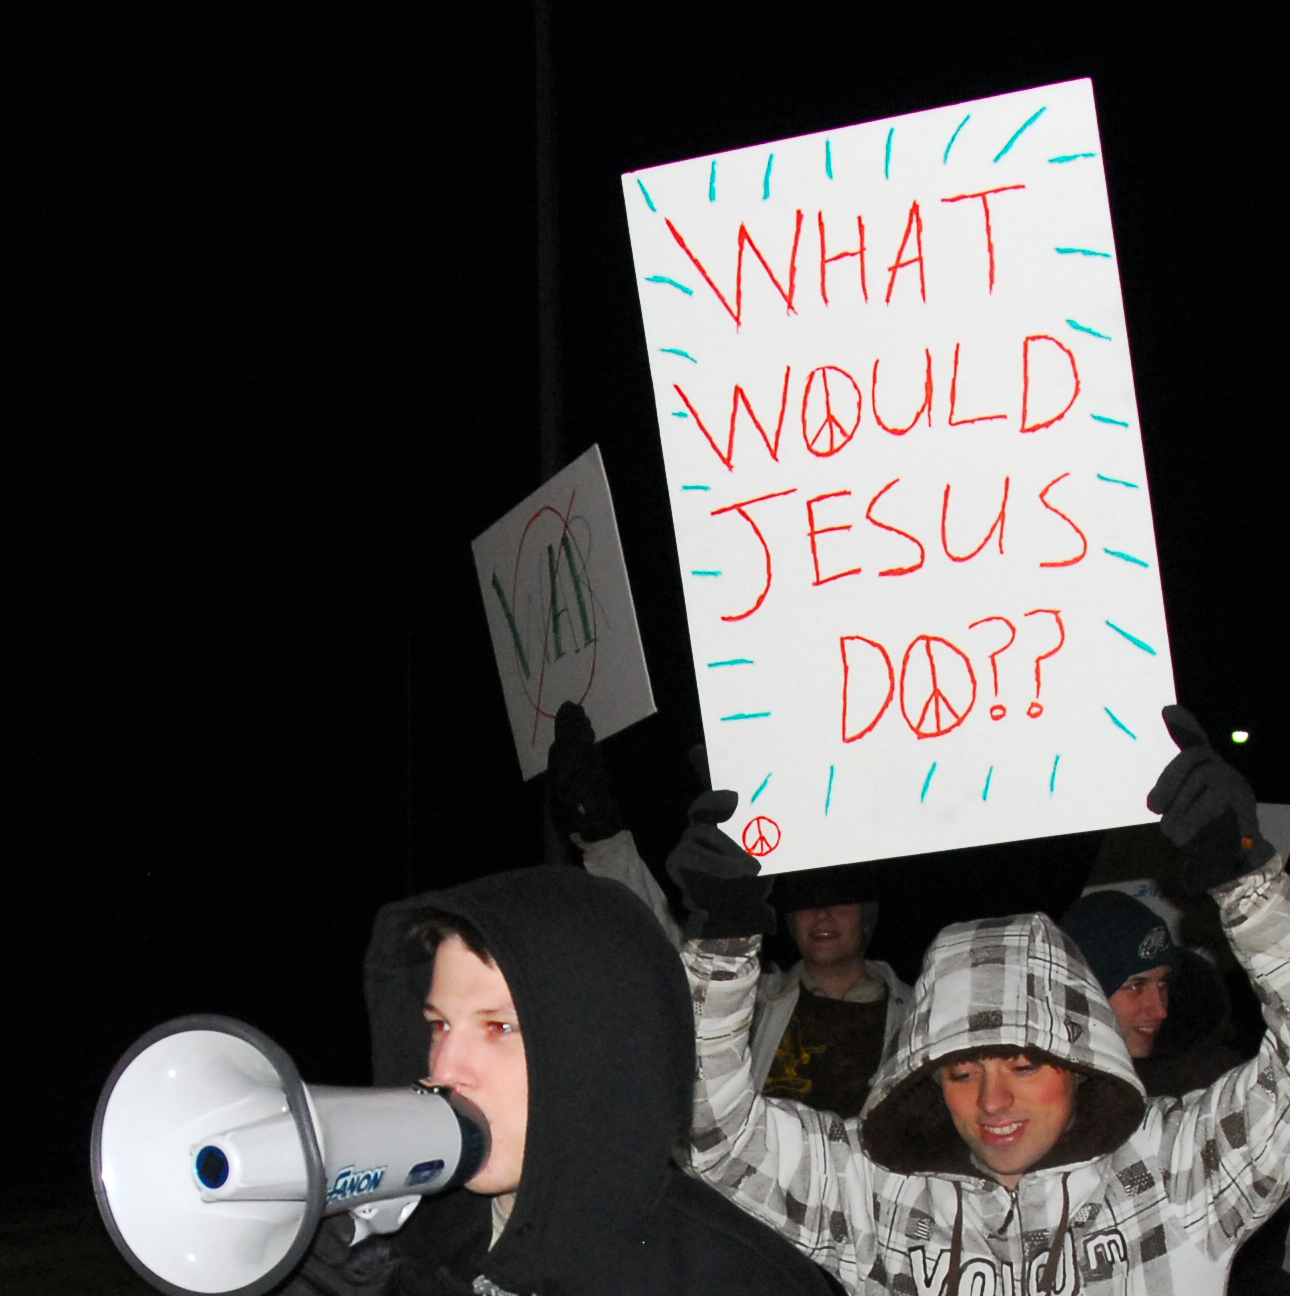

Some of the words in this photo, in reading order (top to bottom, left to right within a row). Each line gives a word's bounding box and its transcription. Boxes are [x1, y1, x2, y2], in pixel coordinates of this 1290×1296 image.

[665, 184, 1026, 331] WHAT
[672, 334, 1082, 472] WOULD
[710, 471, 1089, 622] JESUS
[840, 608, 1066, 744] DO??
